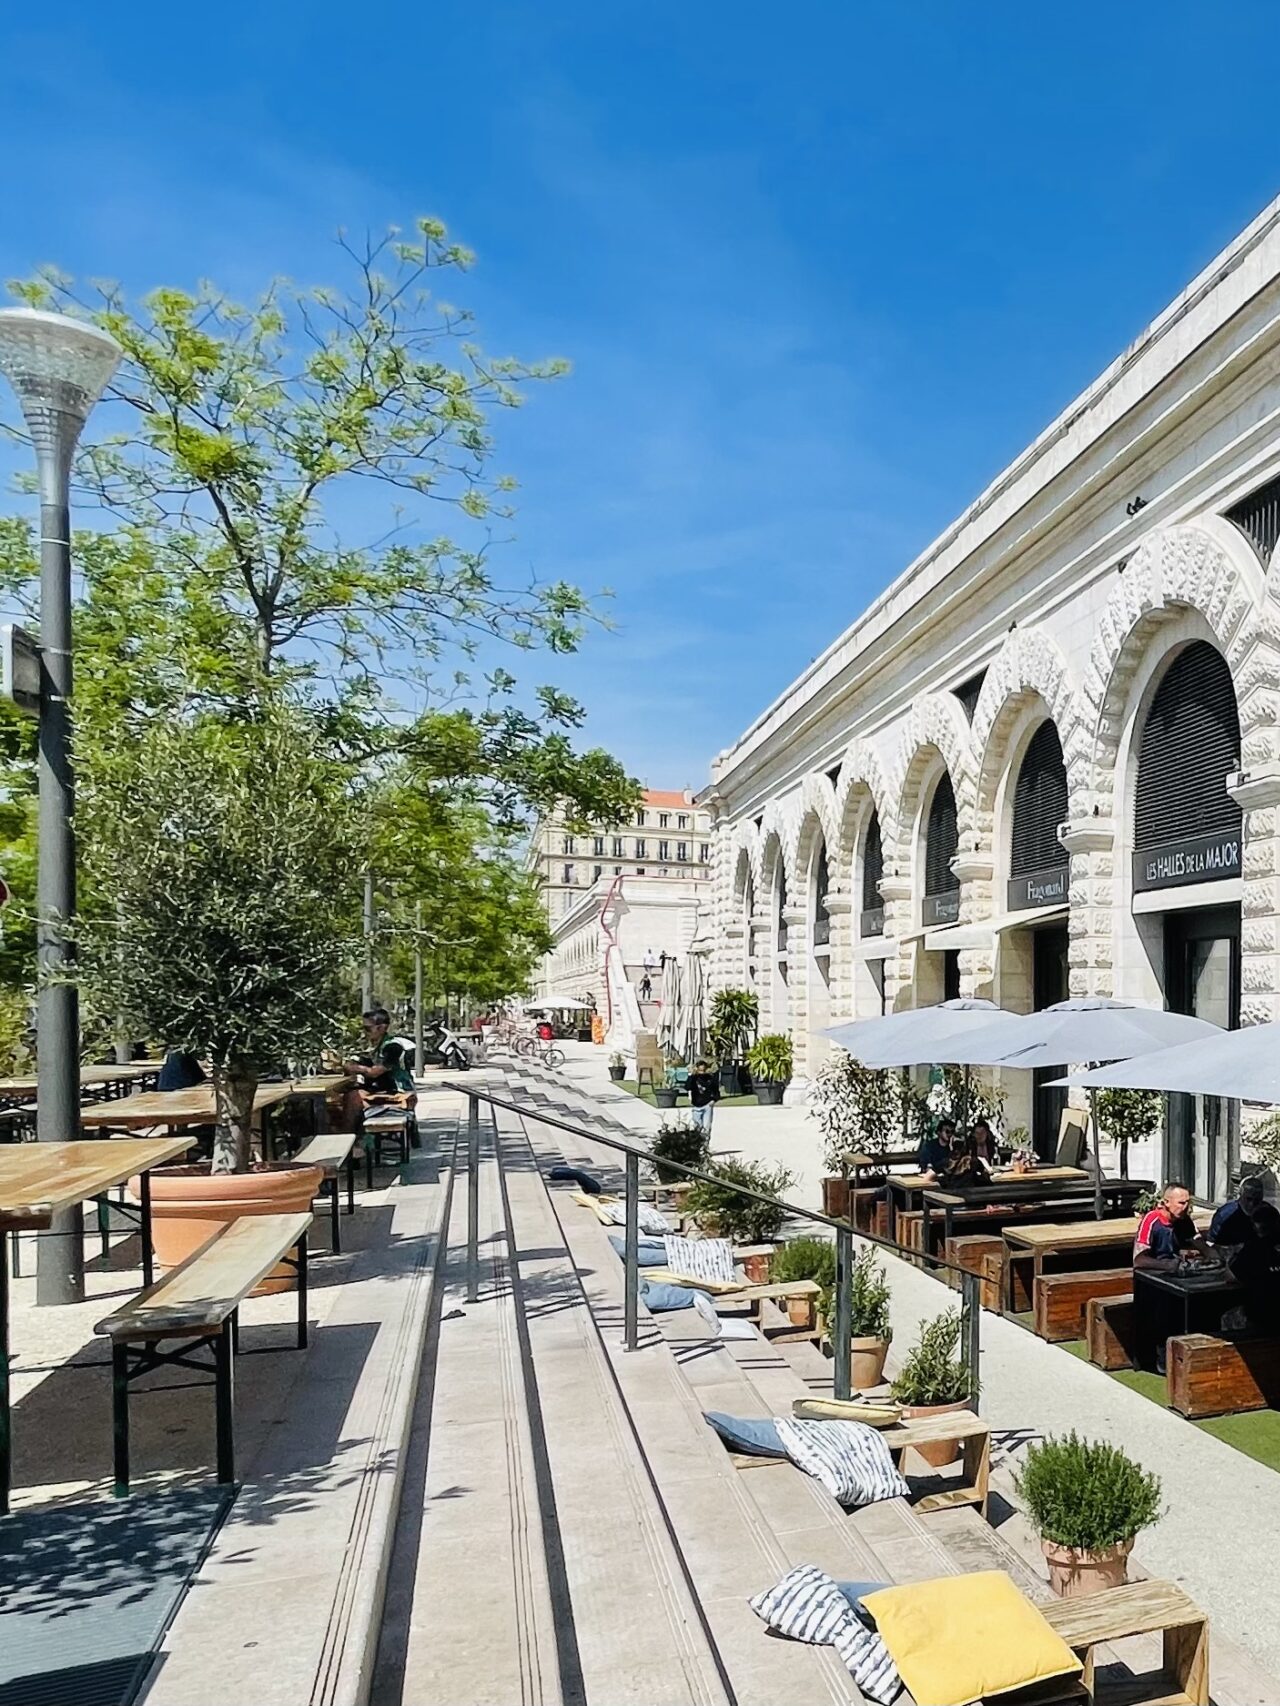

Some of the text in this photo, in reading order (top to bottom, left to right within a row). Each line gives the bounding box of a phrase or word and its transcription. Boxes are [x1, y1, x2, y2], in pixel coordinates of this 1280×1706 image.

[1146, 841, 1238, 881] LES HALLES DE LA MAJOR
